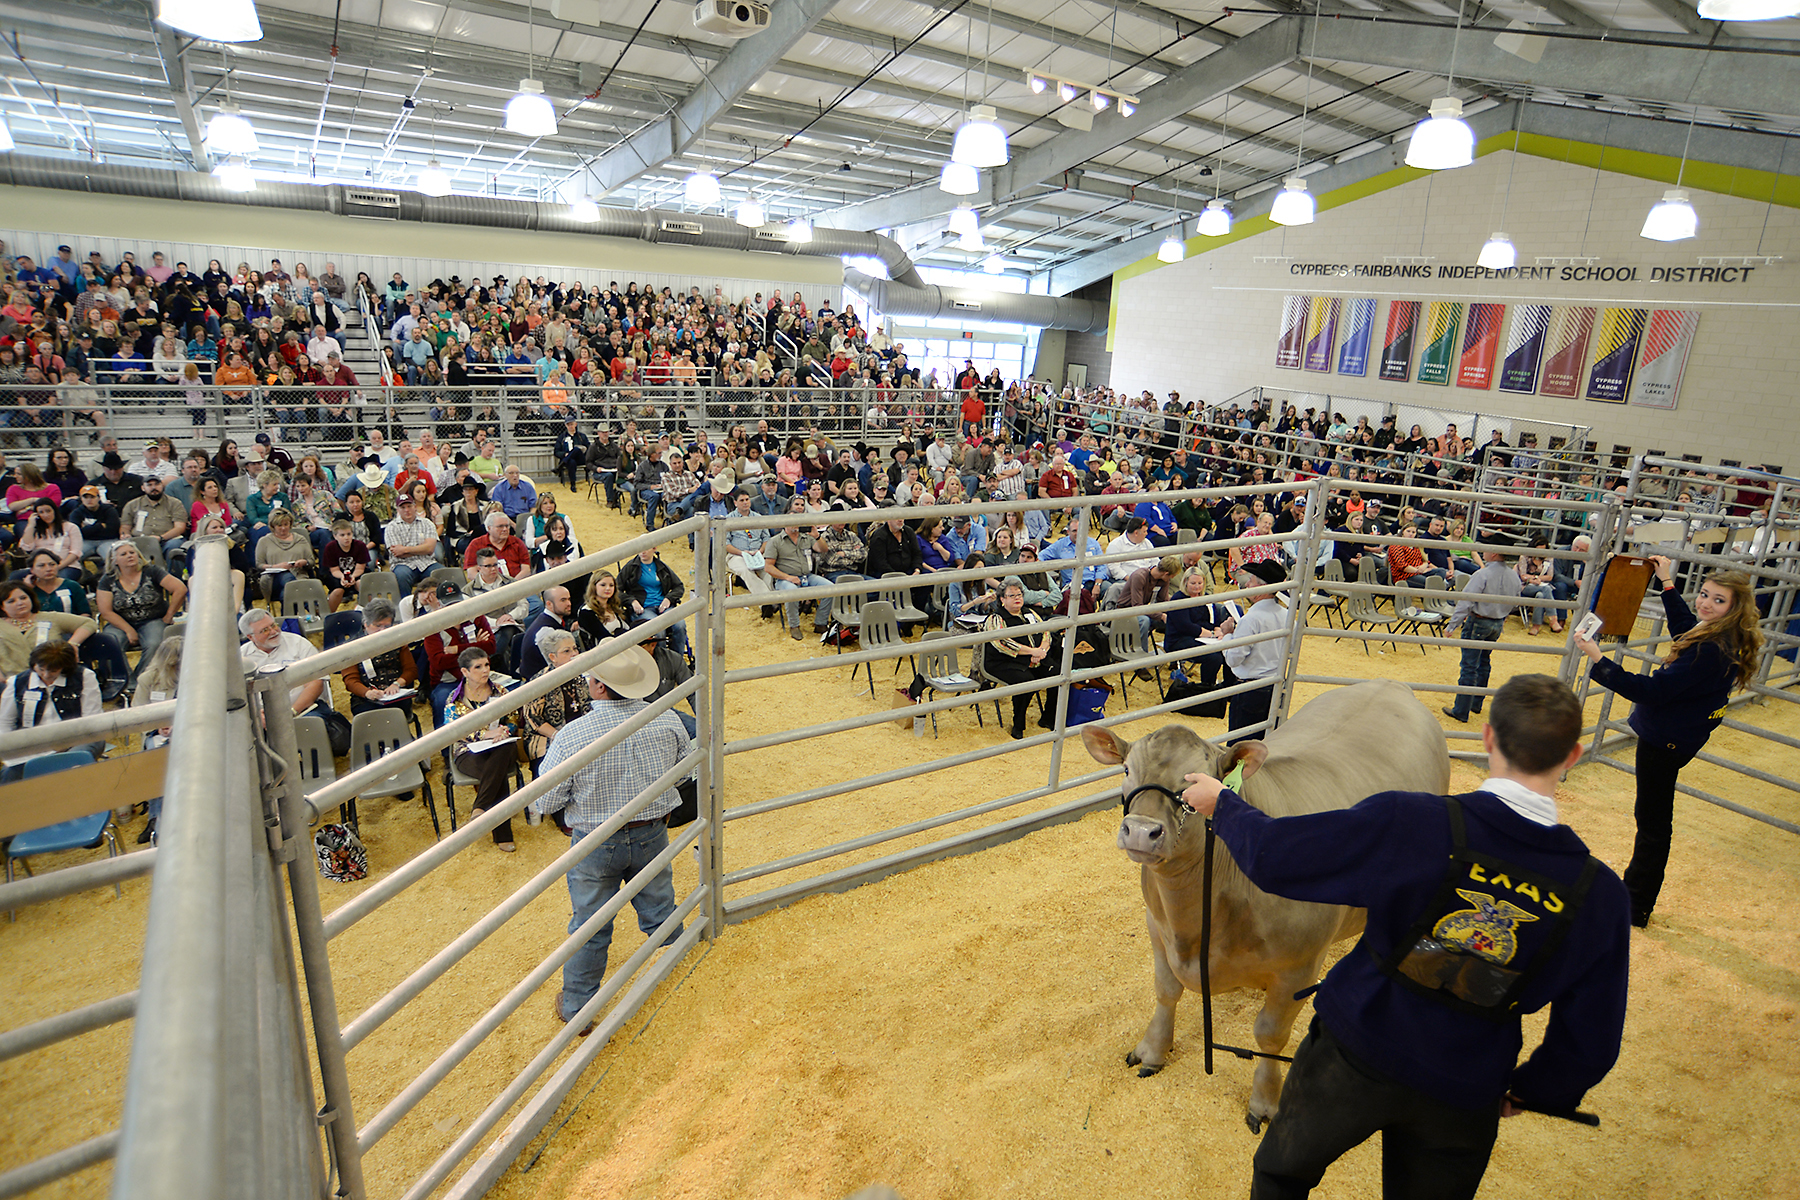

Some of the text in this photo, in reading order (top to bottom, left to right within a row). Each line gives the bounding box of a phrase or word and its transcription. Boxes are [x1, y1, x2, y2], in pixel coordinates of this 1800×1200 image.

[1290, 263, 1754, 283] CYPRESS-FAIRBANKS INDEPENDENT SCHOOL DISTRICT
[1507, 369, 1531, 377] CYPRESS
[1595, 377, 1623, 385] CYPRESS
